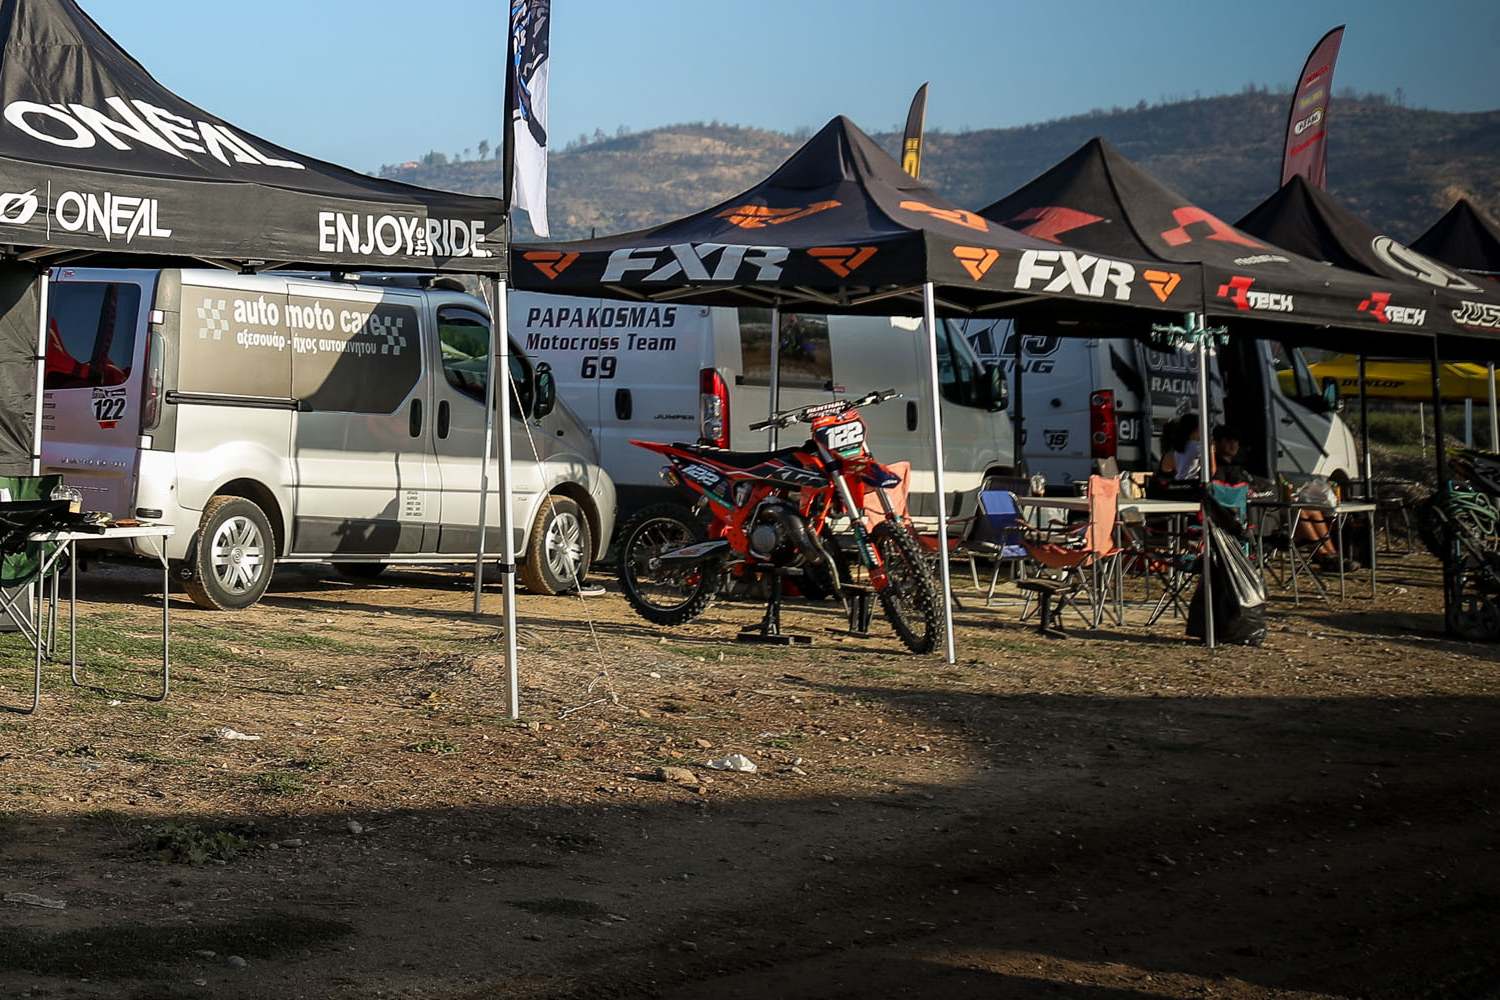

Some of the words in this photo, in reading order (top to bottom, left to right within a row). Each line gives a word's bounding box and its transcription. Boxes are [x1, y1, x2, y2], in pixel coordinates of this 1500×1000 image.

[318, 211, 419, 256] ENJOY
[414, 226, 426, 257] the
[601, 243, 791, 282] FXR
[1013, 249, 1136, 300] FXR
[233, 295, 280, 327] auto
[285, 301, 335, 331] moto
[340, 310, 381, 336] care
[526, 306, 677, 328] PAPAKOSMAS
[1452, 300, 1500, 328] JUS
[237, 328, 286, 352] αξεσουάρ
[525, 333, 620, 350] Motocross
[627, 333, 677, 350] Team
[580, 356, 618, 379] 69
[1151, 376, 1199, 395] RACIN
[94, 398, 126, 421] 122
[825, 420, 864, 450] 122
[681, 463, 721, 487] 122
